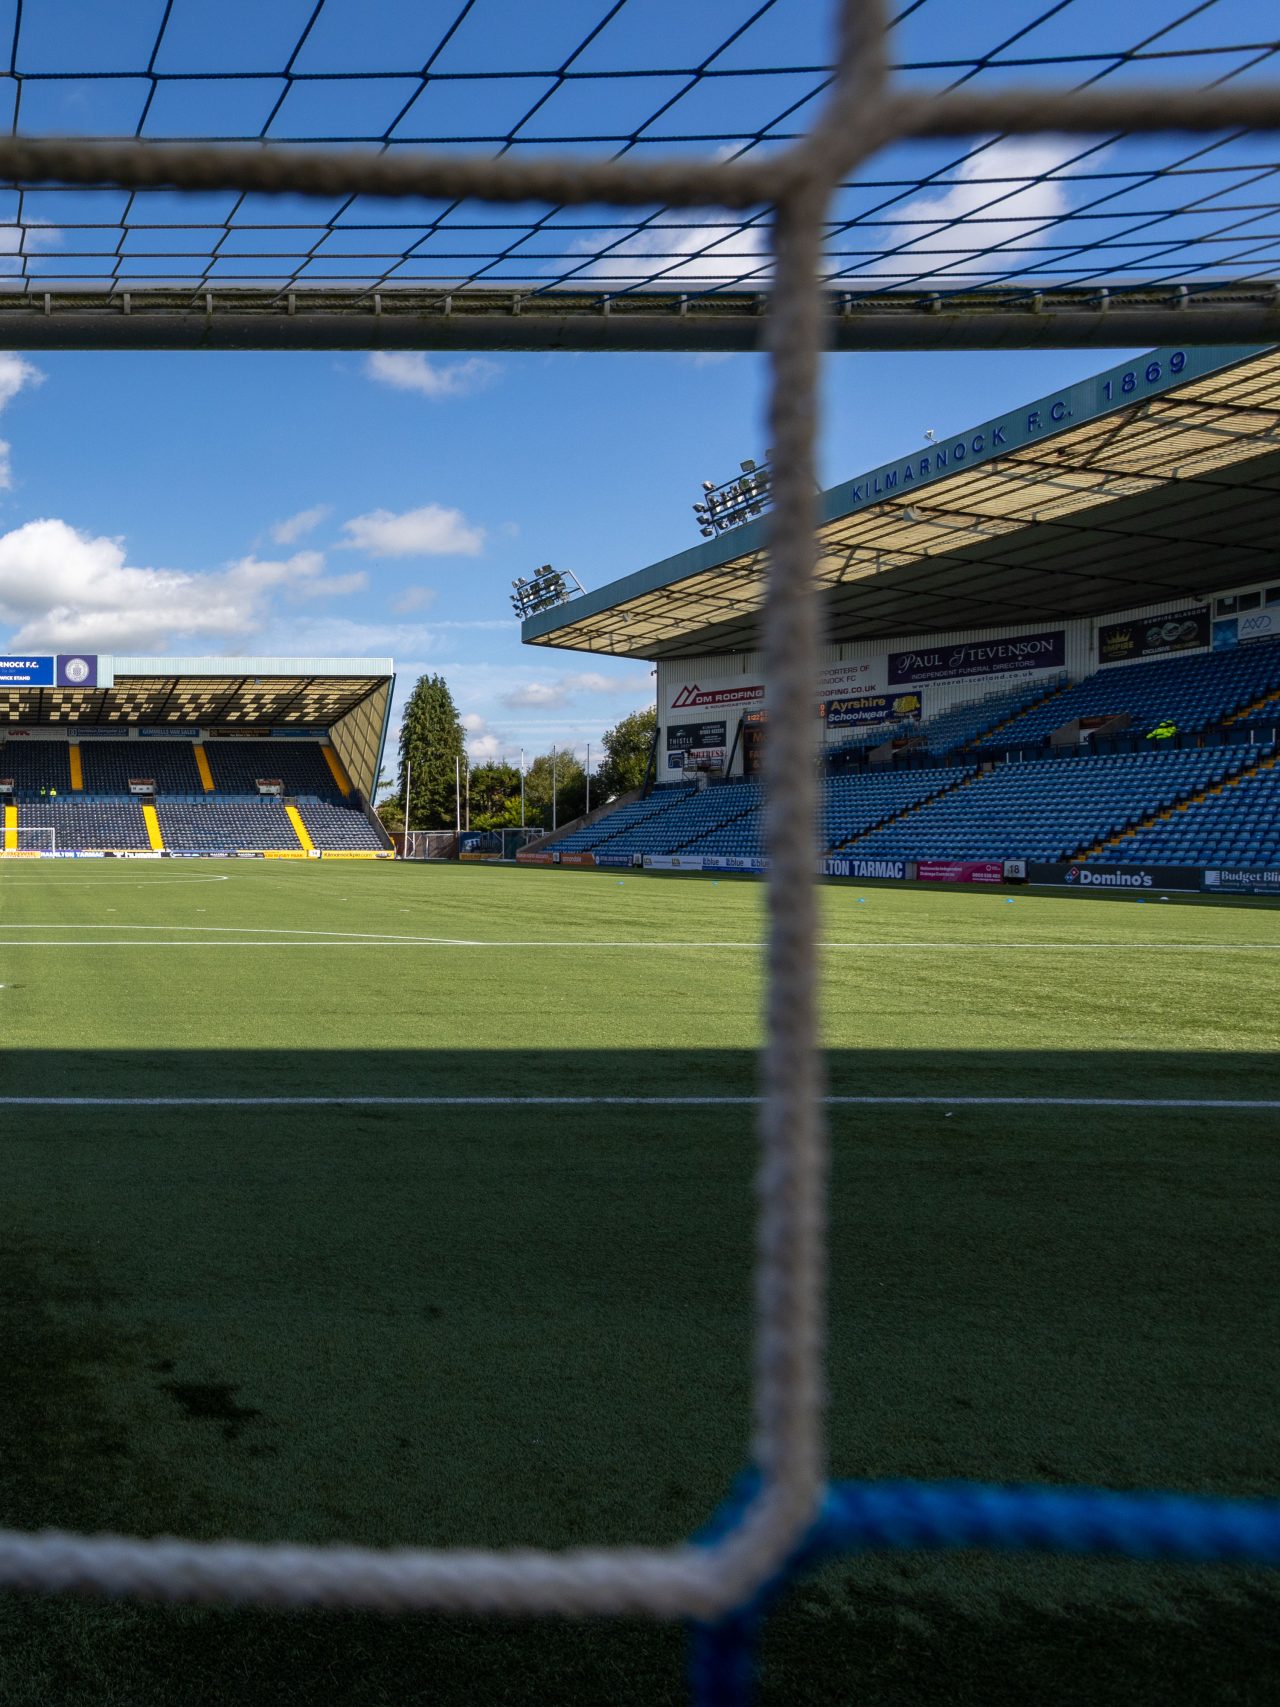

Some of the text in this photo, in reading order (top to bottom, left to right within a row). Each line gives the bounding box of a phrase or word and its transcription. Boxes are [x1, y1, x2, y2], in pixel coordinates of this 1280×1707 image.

[852, 350, 1188, 503] KILMARNOCK F.C. 1869
[897, 640, 1054, 675] PAUL STEVENSON
[911, 660, 1036, 681] INDEPENDENT FUNERAL DIRECTORS
[912, 671, 1034, 689] www.funeral-scotland.co.uk
[696, 690, 764, 704] DM ROOFING
[831, 698, 886, 712] Ayrshire
[828, 710, 889, 722] Schoolwear
[669, 736, 693, 745] THISTLE
[707, 857, 719, 866] blue
[730, 858, 744, 867] blue
[1009, 864, 1019, 874] 18
[852, 861, 903, 879] TARMAC
[1221, 870, 1262, 883] Budget
[1080, 870, 1153, 886] Domino's
